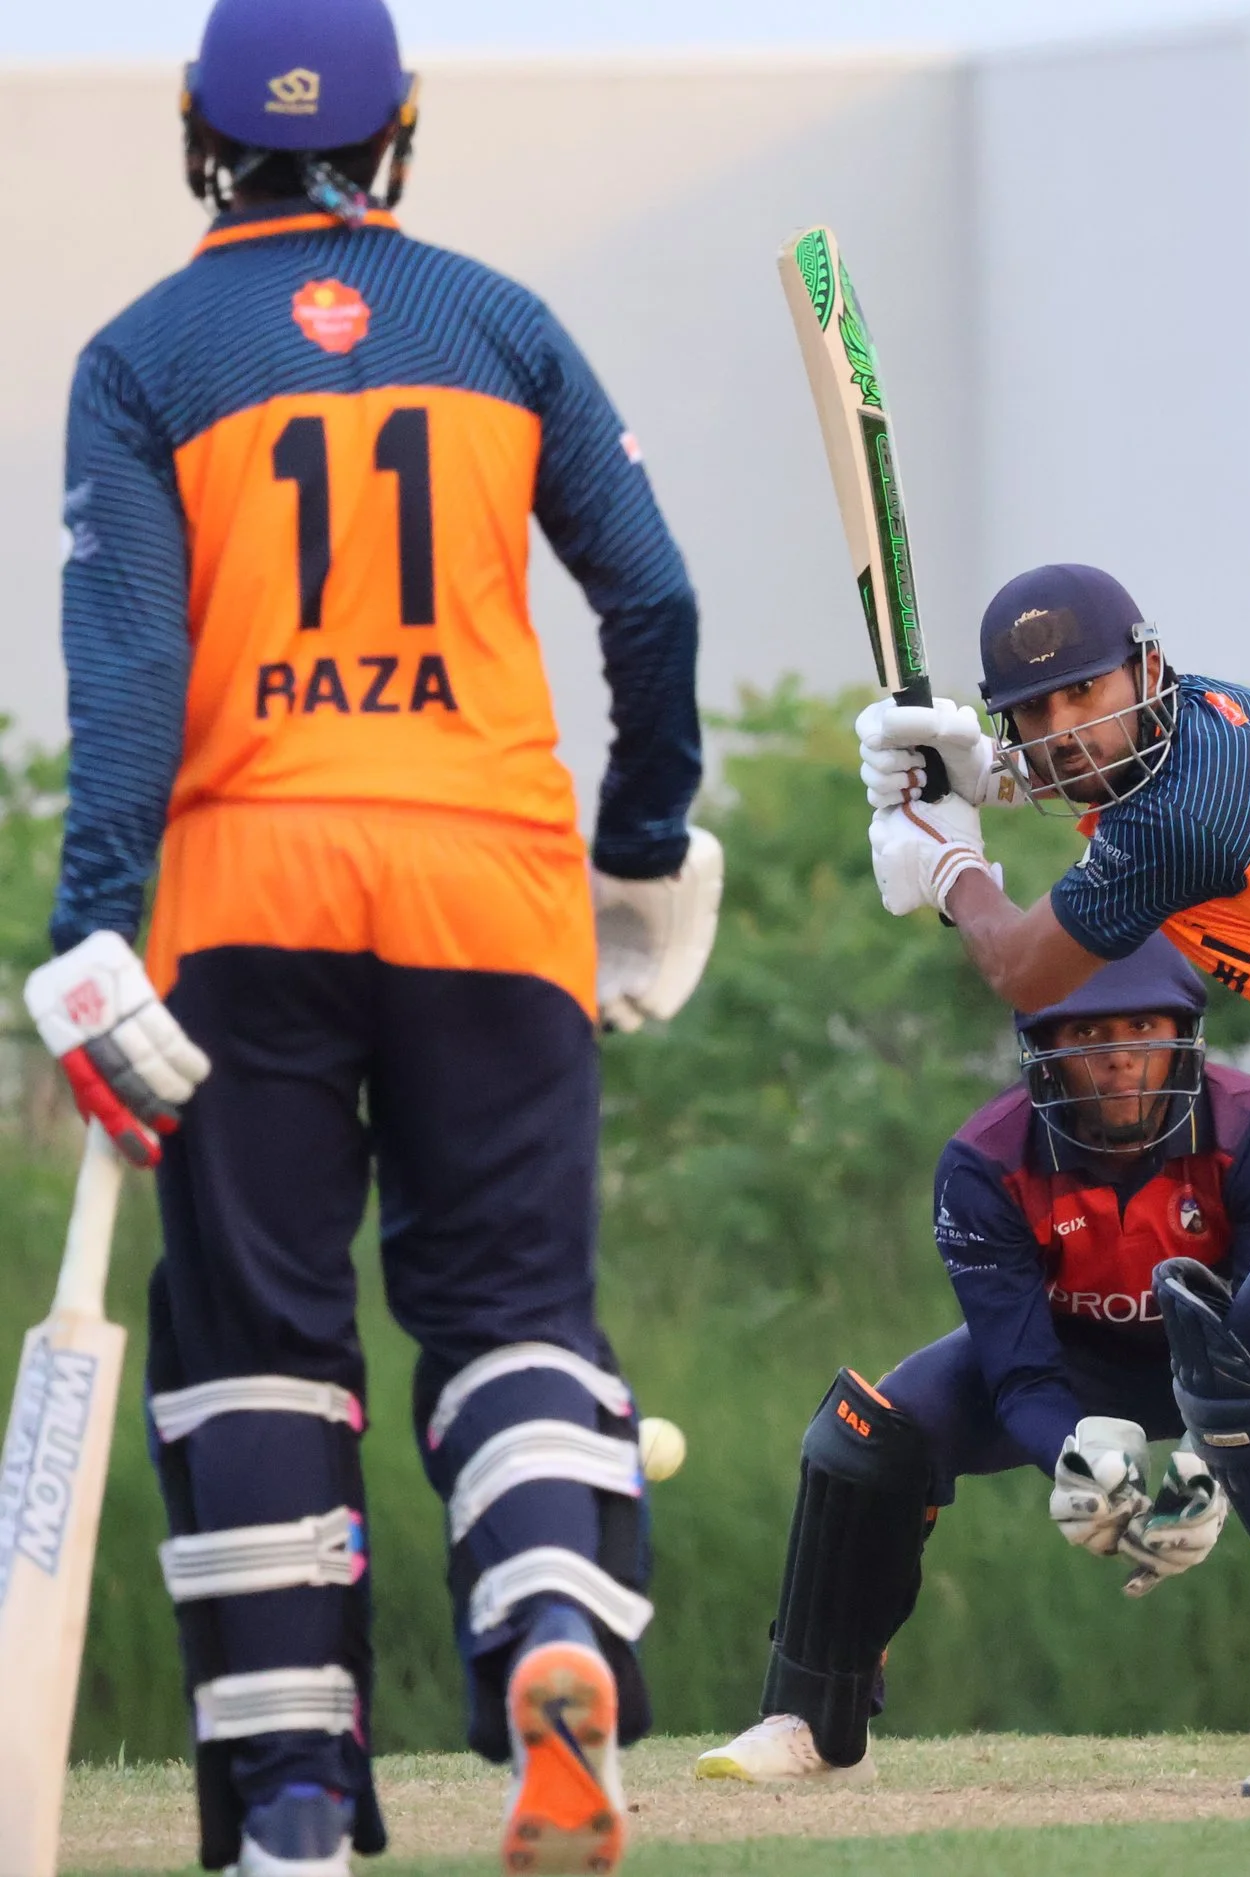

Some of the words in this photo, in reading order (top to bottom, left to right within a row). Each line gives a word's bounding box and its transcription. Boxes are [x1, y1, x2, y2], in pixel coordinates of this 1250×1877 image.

[272, 407, 437, 630] 11
[257, 655, 459, 719] RAZA
[836, 1400, 871, 1438] BAS
